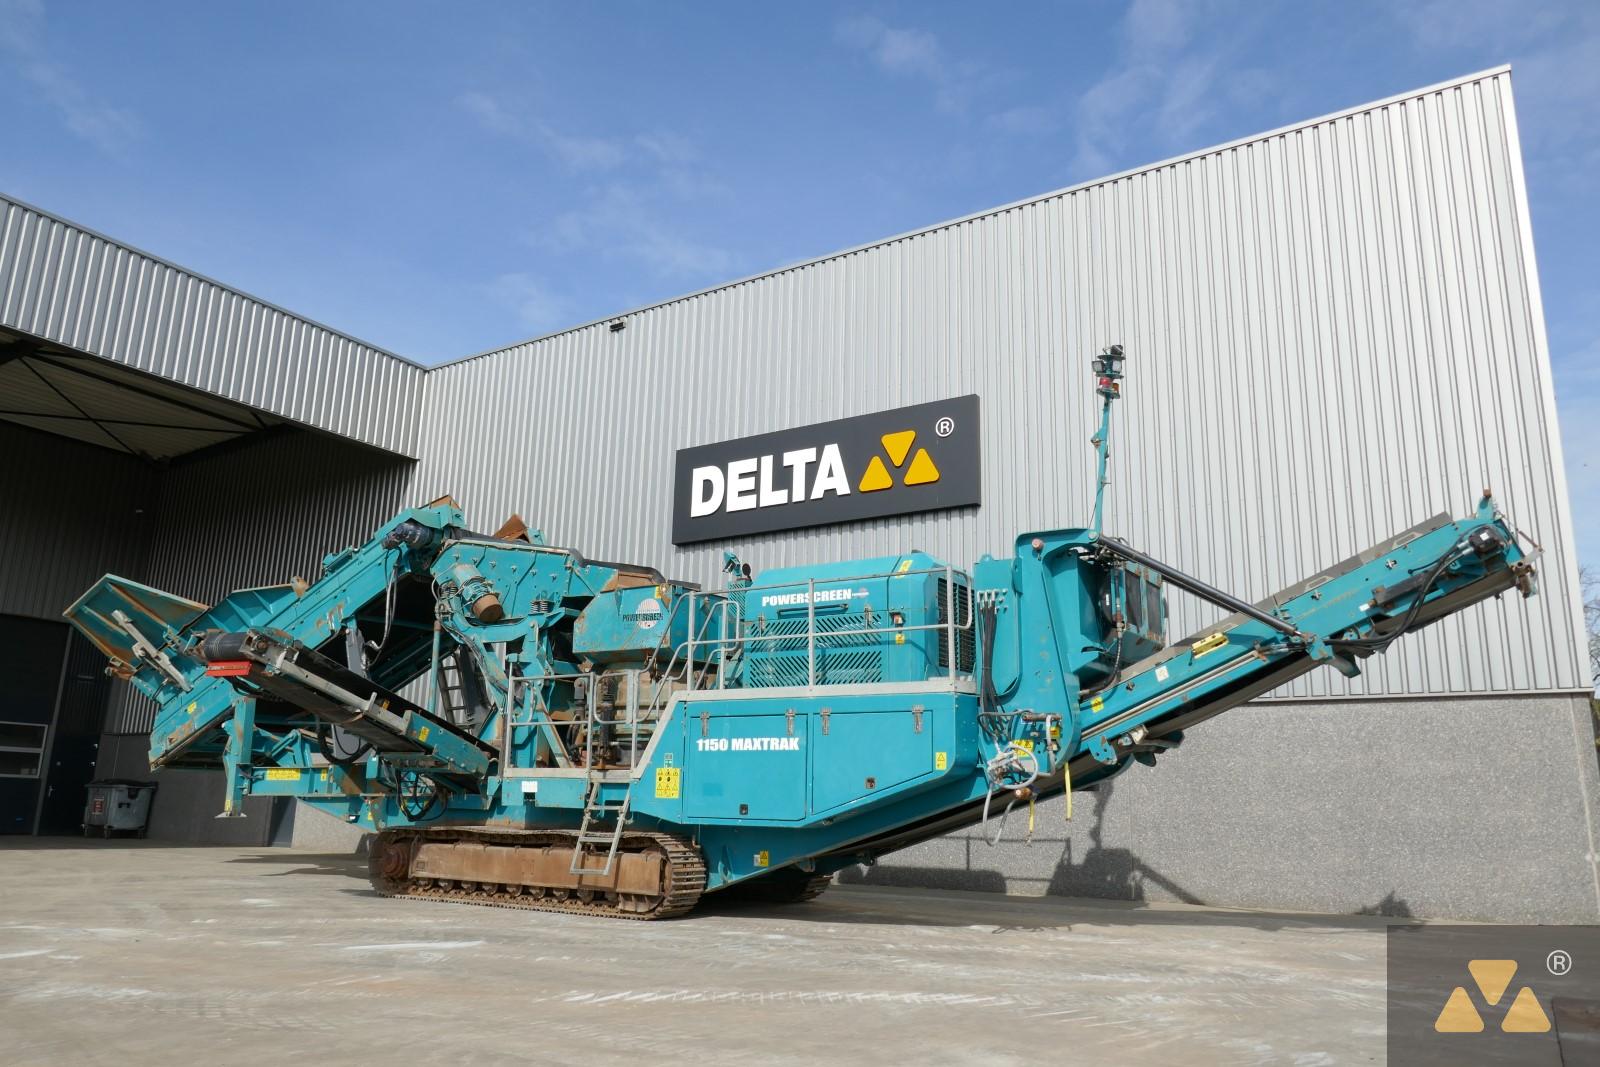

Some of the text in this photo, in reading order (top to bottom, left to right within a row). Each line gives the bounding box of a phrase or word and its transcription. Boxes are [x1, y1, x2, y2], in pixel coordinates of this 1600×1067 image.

[691, 443, 851, 518] DELTA
[762, 588, 852, 607] POWERSCREEN
[696, 737, 799, 751] 1150 MAXTRAK
